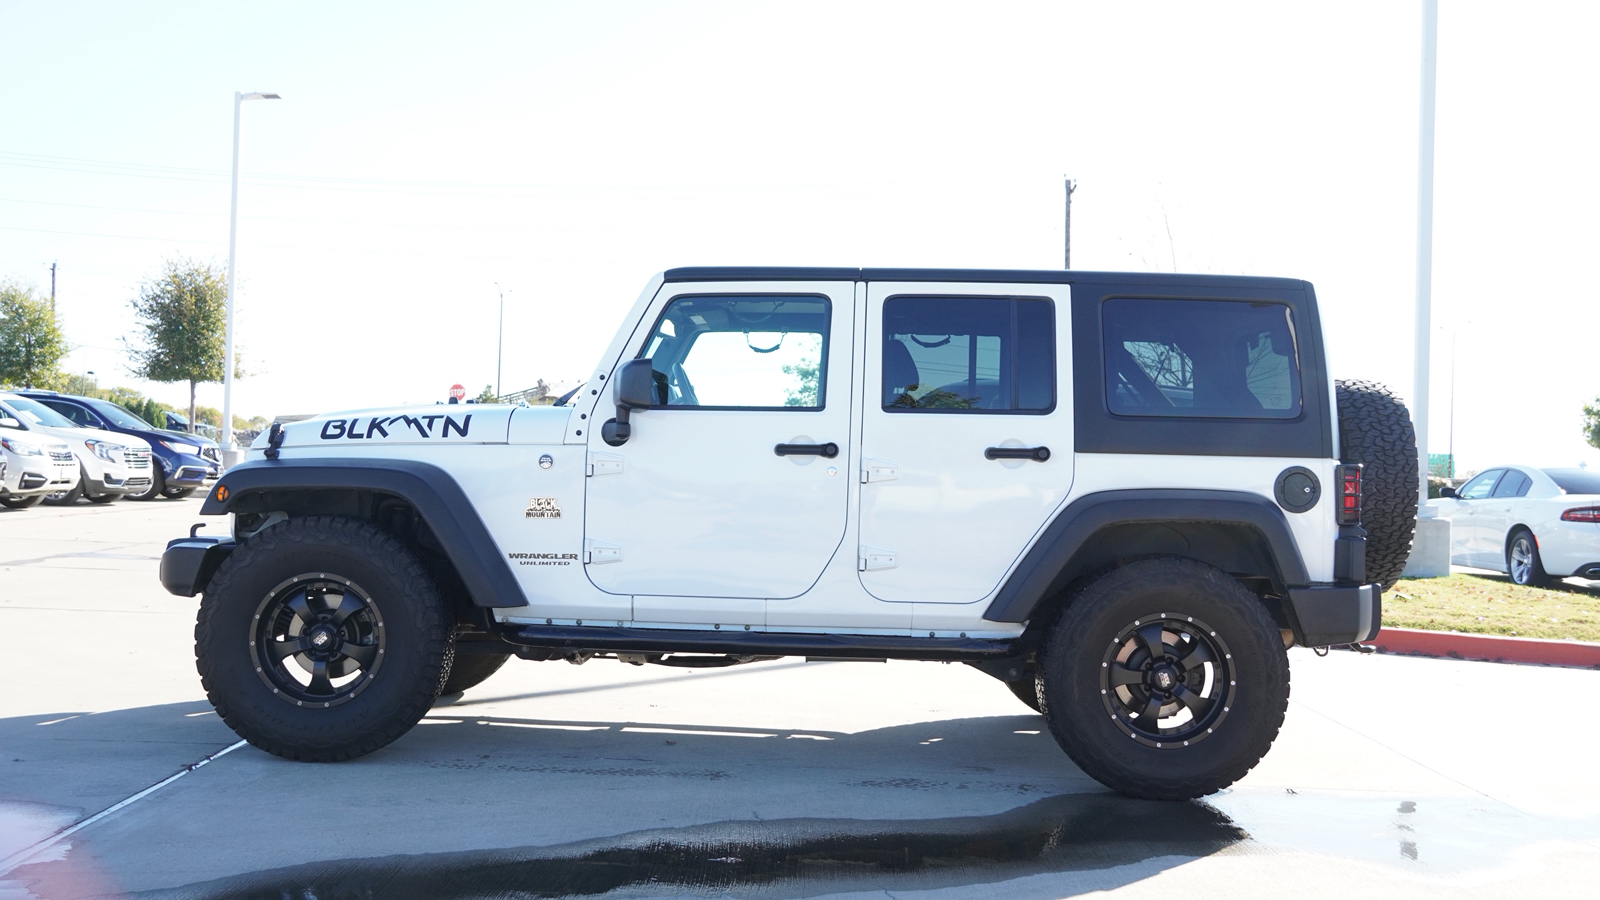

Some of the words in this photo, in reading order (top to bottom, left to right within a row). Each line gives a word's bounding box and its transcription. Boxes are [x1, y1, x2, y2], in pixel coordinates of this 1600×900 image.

[450, 388, 465, 397] STOP
[525, 511, 561, 519] MOUNTAIN
[508, 552, 579, 560] WRANGLER
